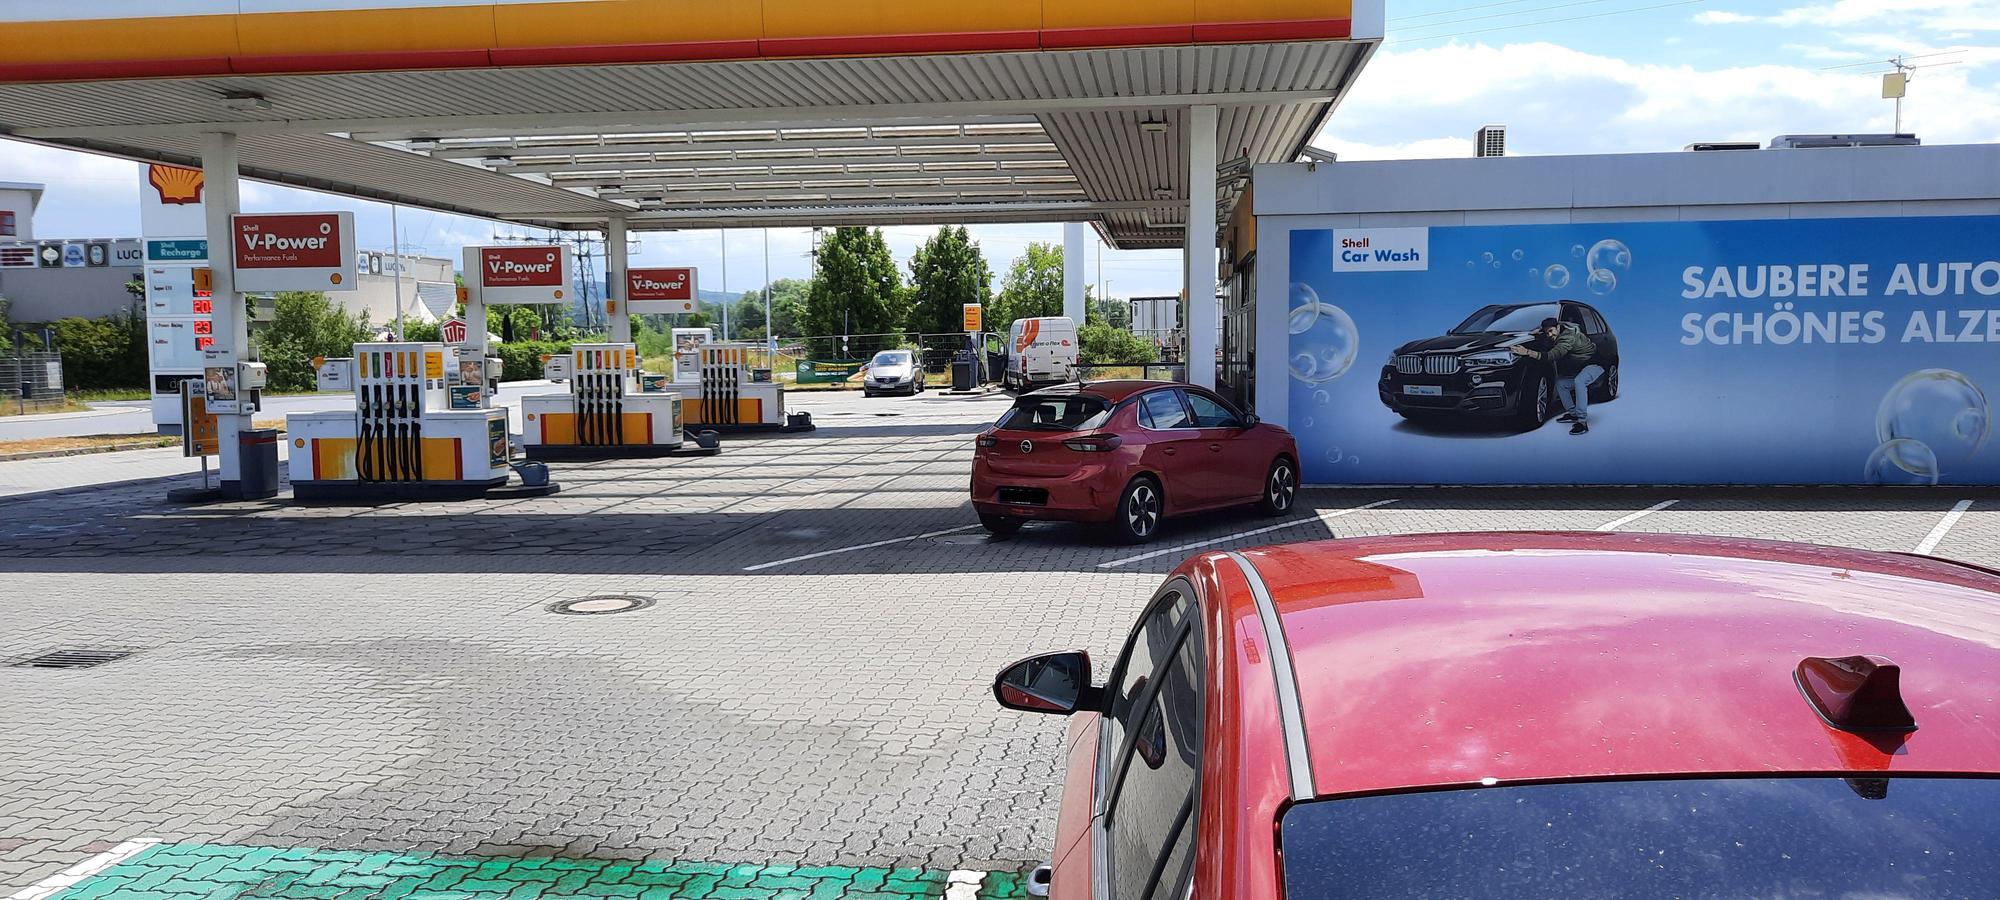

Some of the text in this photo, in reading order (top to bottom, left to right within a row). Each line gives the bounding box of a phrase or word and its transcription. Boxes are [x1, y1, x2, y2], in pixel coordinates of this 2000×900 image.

[243, 233, 328, 251] V-Power
[1342, 238, 1369, 248] Shell
[160, 248, 202, 258] Recharge
[244, 253, 298, 262] Performance Fuels
[1342, 248, 1420, 263] Car Wash
[488, 261, 553, 274] V-Power
[632, 280, 684, 290] V-Power
[1680, 261, 2000, 299] SAUBERE AUTO
[1680, 301, 1887, 346] SCHÖNES
[443, 320, 467, 343] UTA
